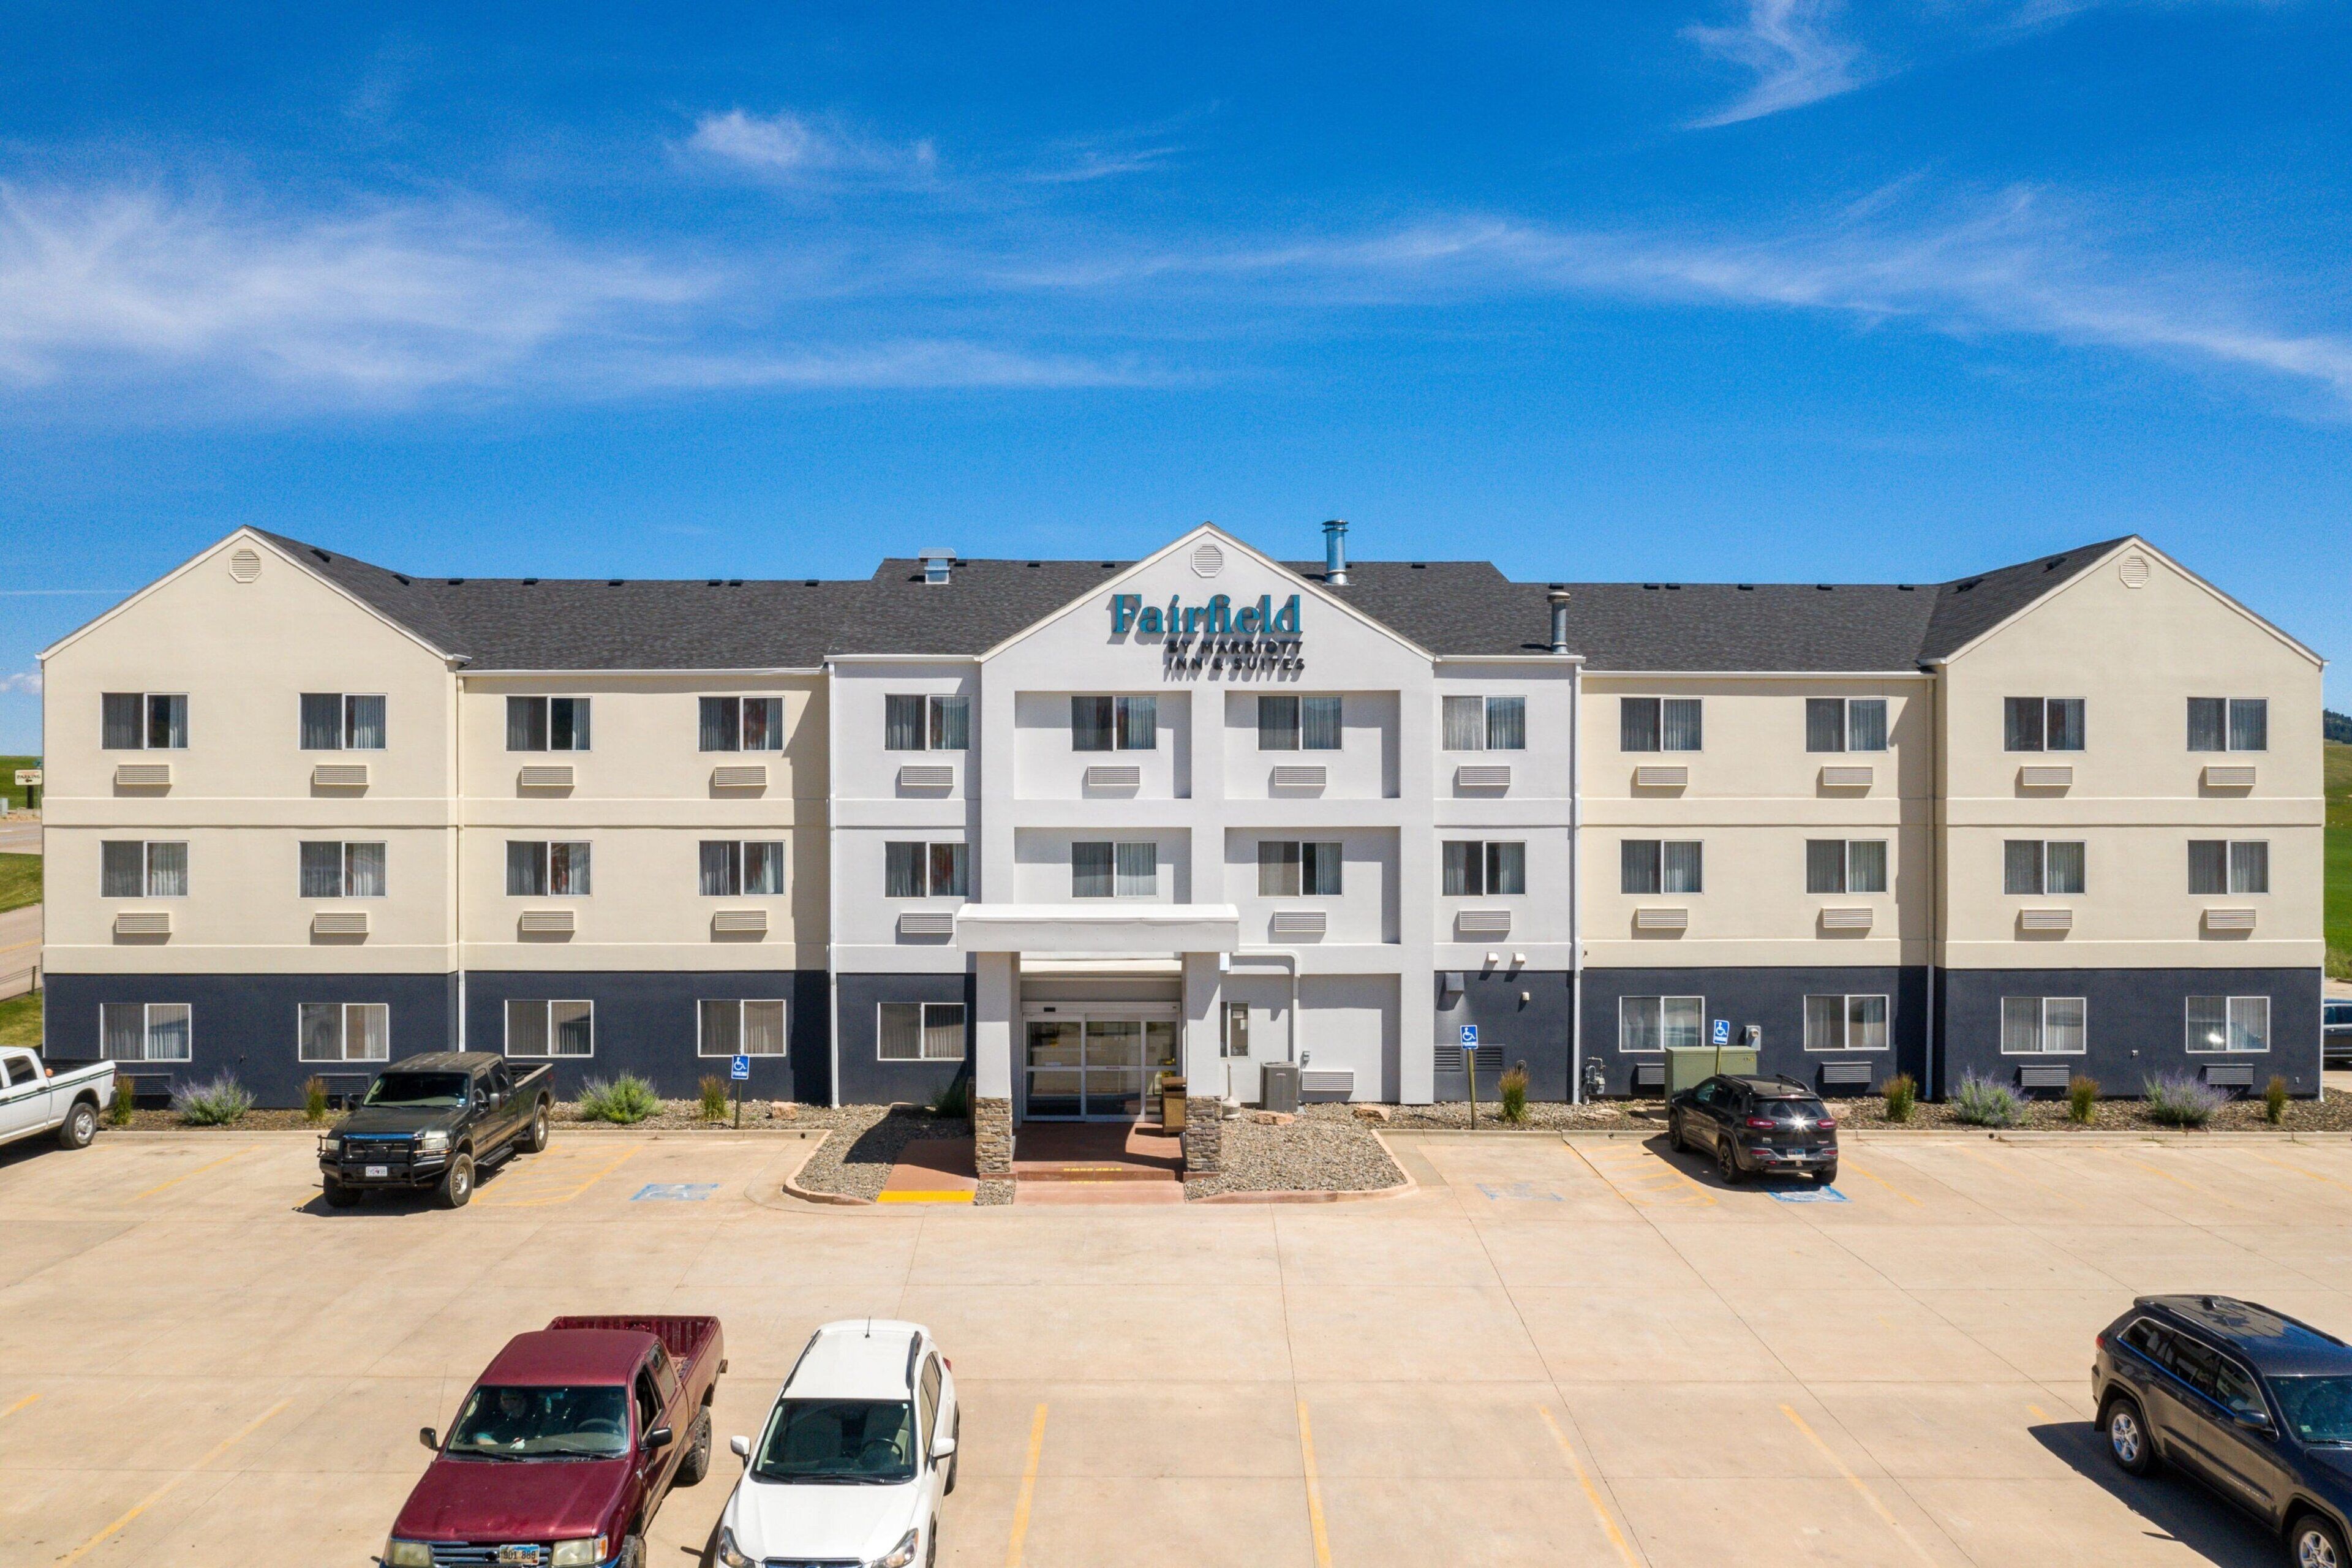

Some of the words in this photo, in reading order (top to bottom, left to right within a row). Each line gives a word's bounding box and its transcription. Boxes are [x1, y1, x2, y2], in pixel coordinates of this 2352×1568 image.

[1112, 594, 1301, 634] Fairfield
[1168, 640, 1191, 654] BY
[1201, 641, 1303, 654] MARRIOTT
[1169, 658, 1203, 670] INN
[1213, 657, 1223, 670] &
[1234, 657, 1305, 671] SUITES
